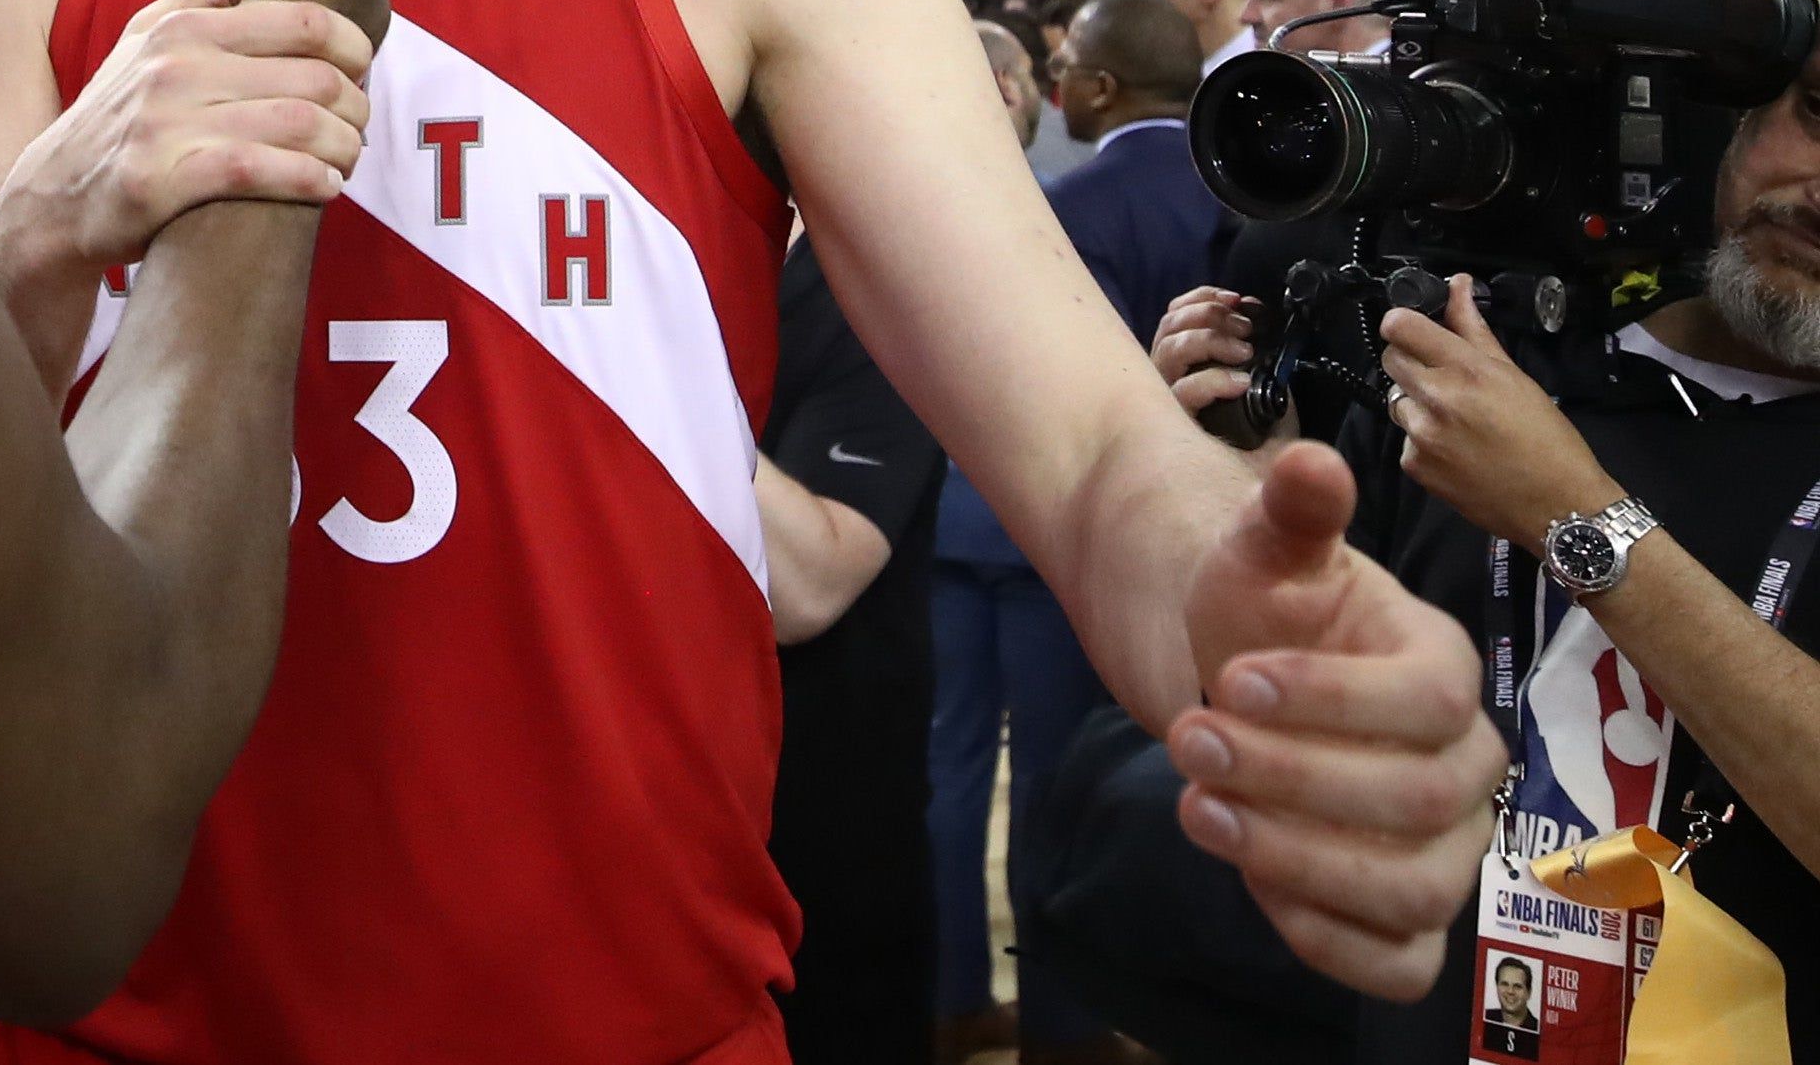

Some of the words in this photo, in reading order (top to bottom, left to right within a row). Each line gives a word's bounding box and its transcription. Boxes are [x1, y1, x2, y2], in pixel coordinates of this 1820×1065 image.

[290, 320, 458, 563] 3
[1493, 561, 1510, 598] FINALS
[1759, 557, 1792, 601] FINALS
[1496, 646, 1513, 672] NBA
[1495, 671, 1514, 709] FINALS
[1511, 892, 1542, 925] NBA
[1546, 899, 1599, 937] FINALS
[1600, 909, 1622, 942] 2019
[1547, 965, 1580, 991] PETER
[1506, 1030, 1516, 1052] S
